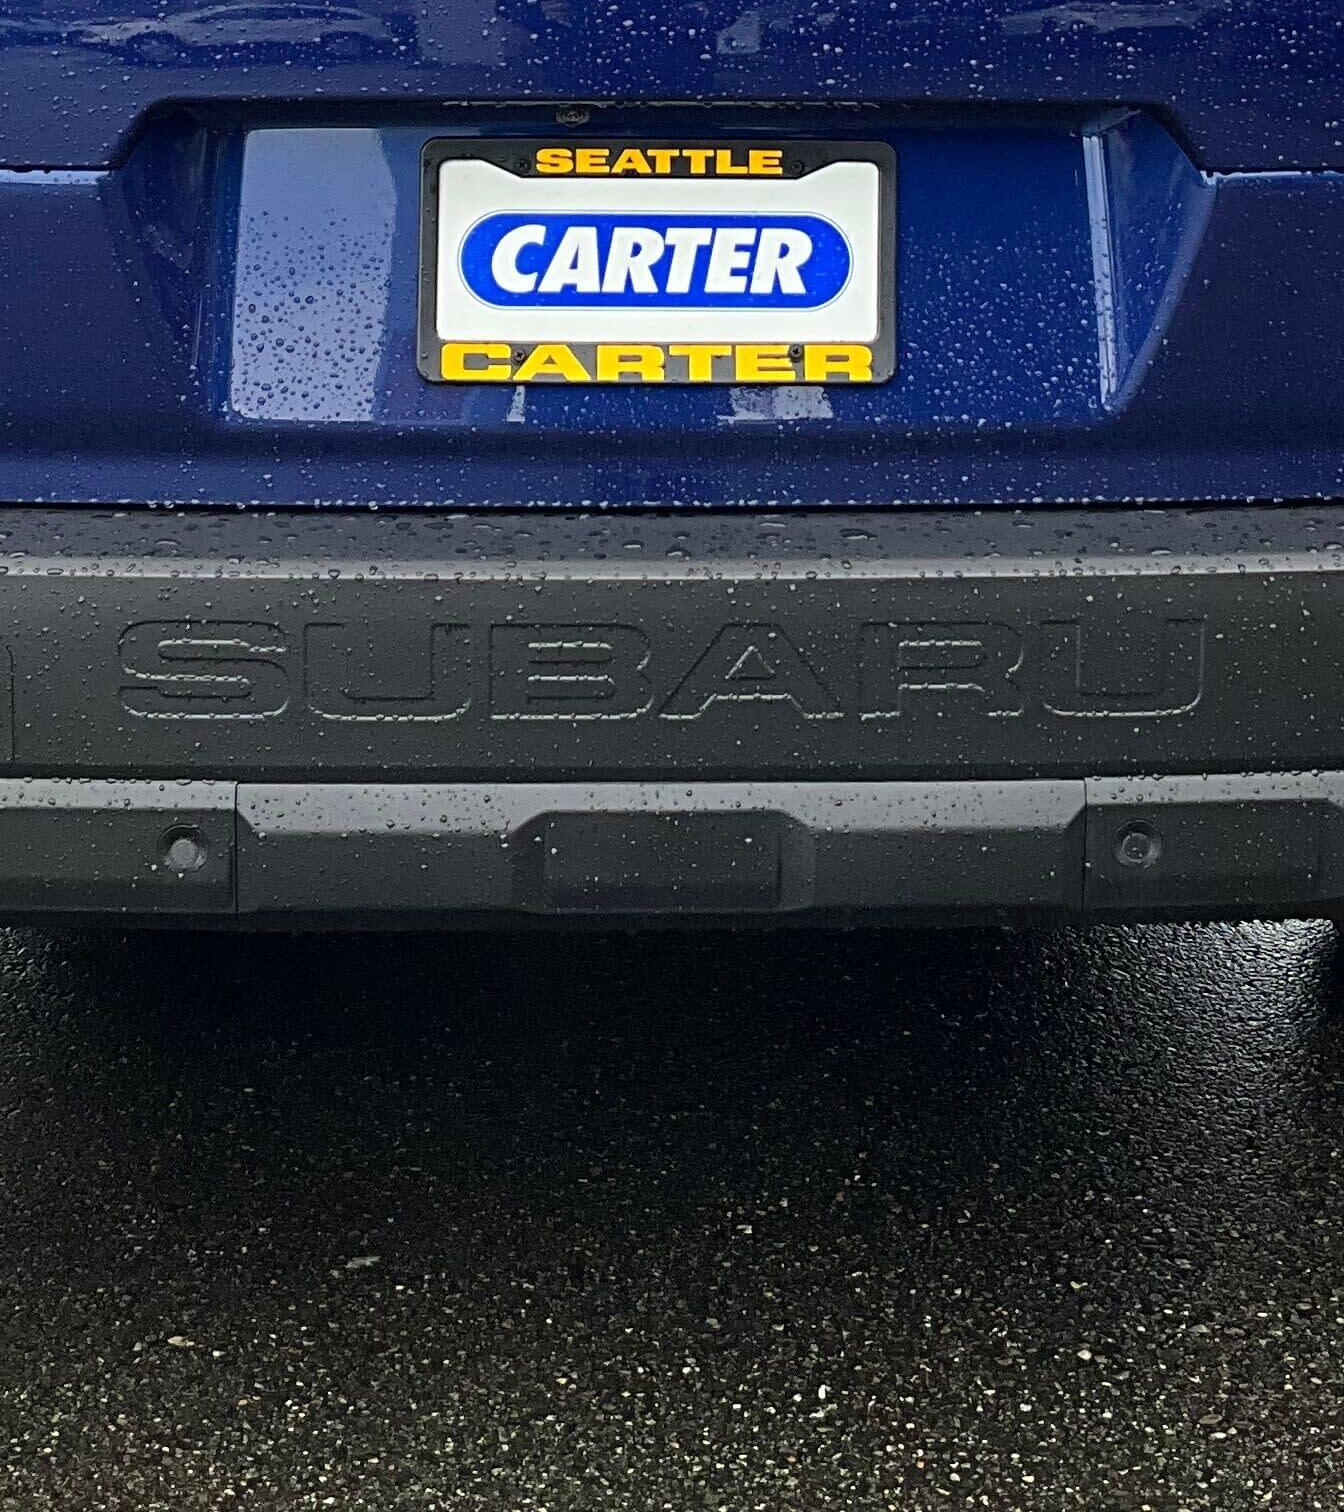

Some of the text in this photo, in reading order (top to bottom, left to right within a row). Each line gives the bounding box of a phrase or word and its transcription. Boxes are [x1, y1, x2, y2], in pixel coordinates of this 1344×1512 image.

[536, 148, 784, 176] SEATTLE
[490, 223, 813, 295] CARTER
[440, 343, 874, 383] CARTER
[117, 619, 1206, 721] SUBARU
